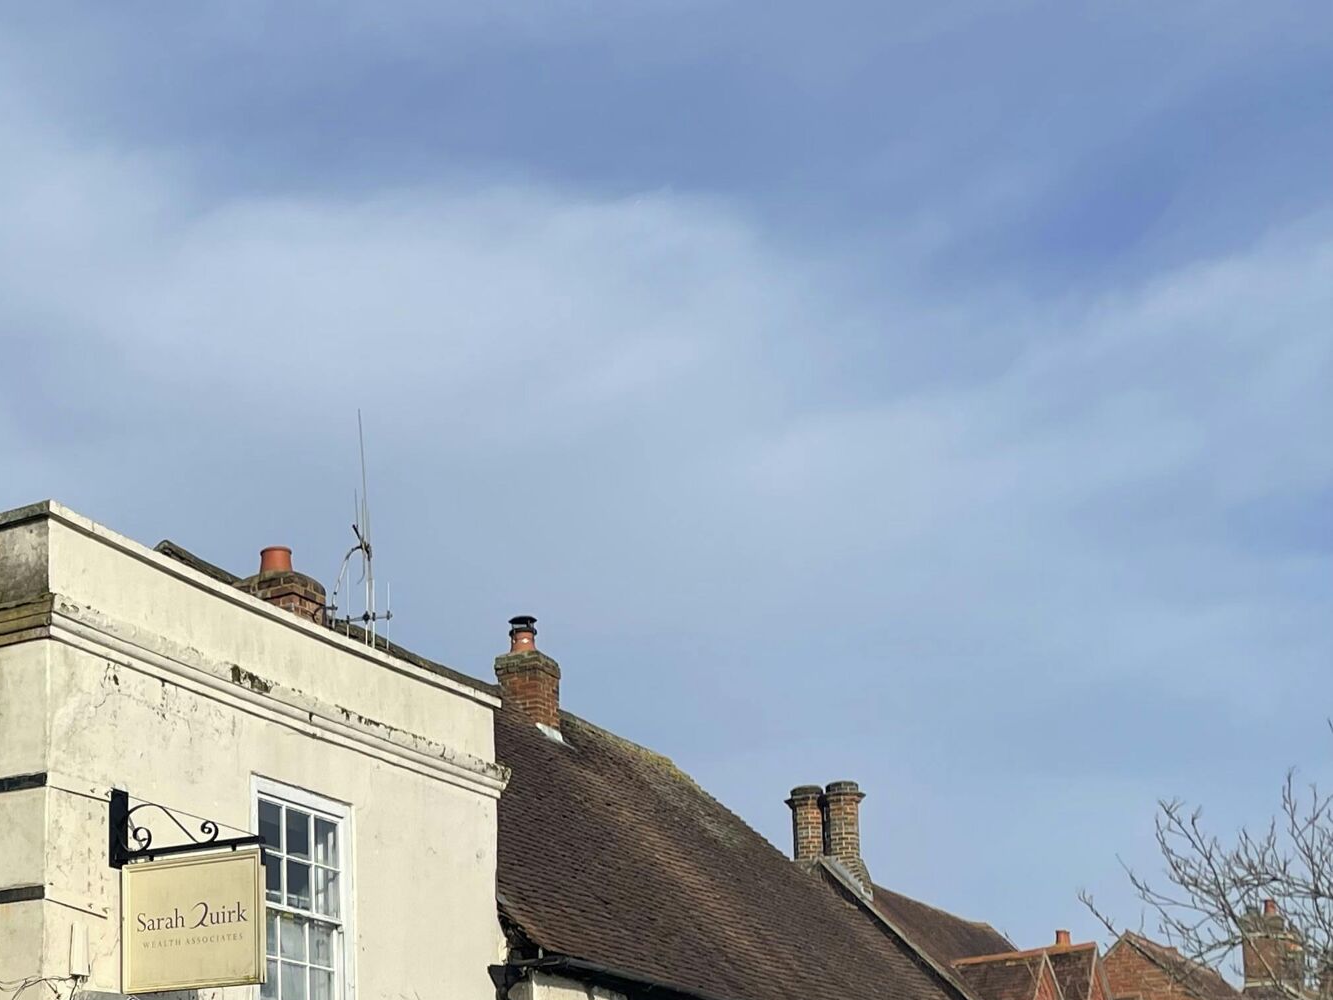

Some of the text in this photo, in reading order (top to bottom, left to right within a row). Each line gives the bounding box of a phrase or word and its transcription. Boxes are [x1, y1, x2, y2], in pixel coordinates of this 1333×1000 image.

[137, 901, 248, 932] Sarah Quirk
[142, 932, 243, 949] WEALTH ASSOCIATES
